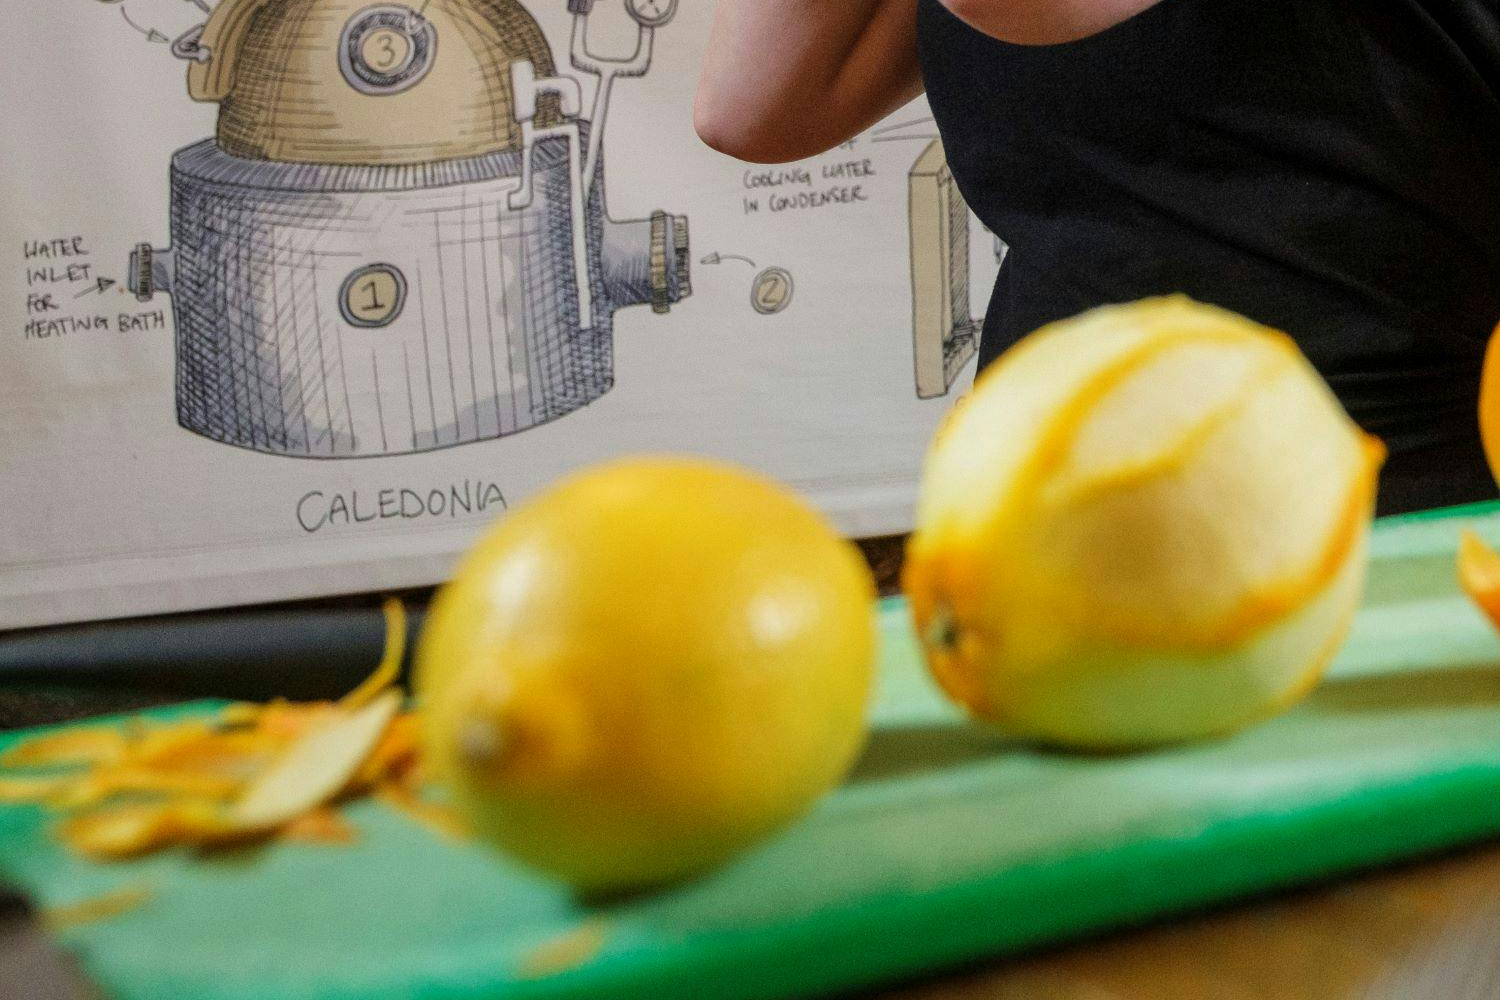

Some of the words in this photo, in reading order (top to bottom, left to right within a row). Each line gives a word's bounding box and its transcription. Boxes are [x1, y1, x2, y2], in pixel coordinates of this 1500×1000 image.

[377, 36, 396, 67] 3
[743, 169, 812, 189] COOLING
[822, 158, 876, 179] WATER
[743, 197, 759, 215] IN
[769, 184, 868, 212] CONDENSER
[24, 236, 89, 259] WATER
[26, 263, 91, 287] INLET
[26, 293, 59, 314] FOR
[360, 280, 385, 311] 1
[24, 315, 109, 340] HEATING
[118, 310, 166, 334] BATH
[296, 478, 508, 533] CALEDONIA
